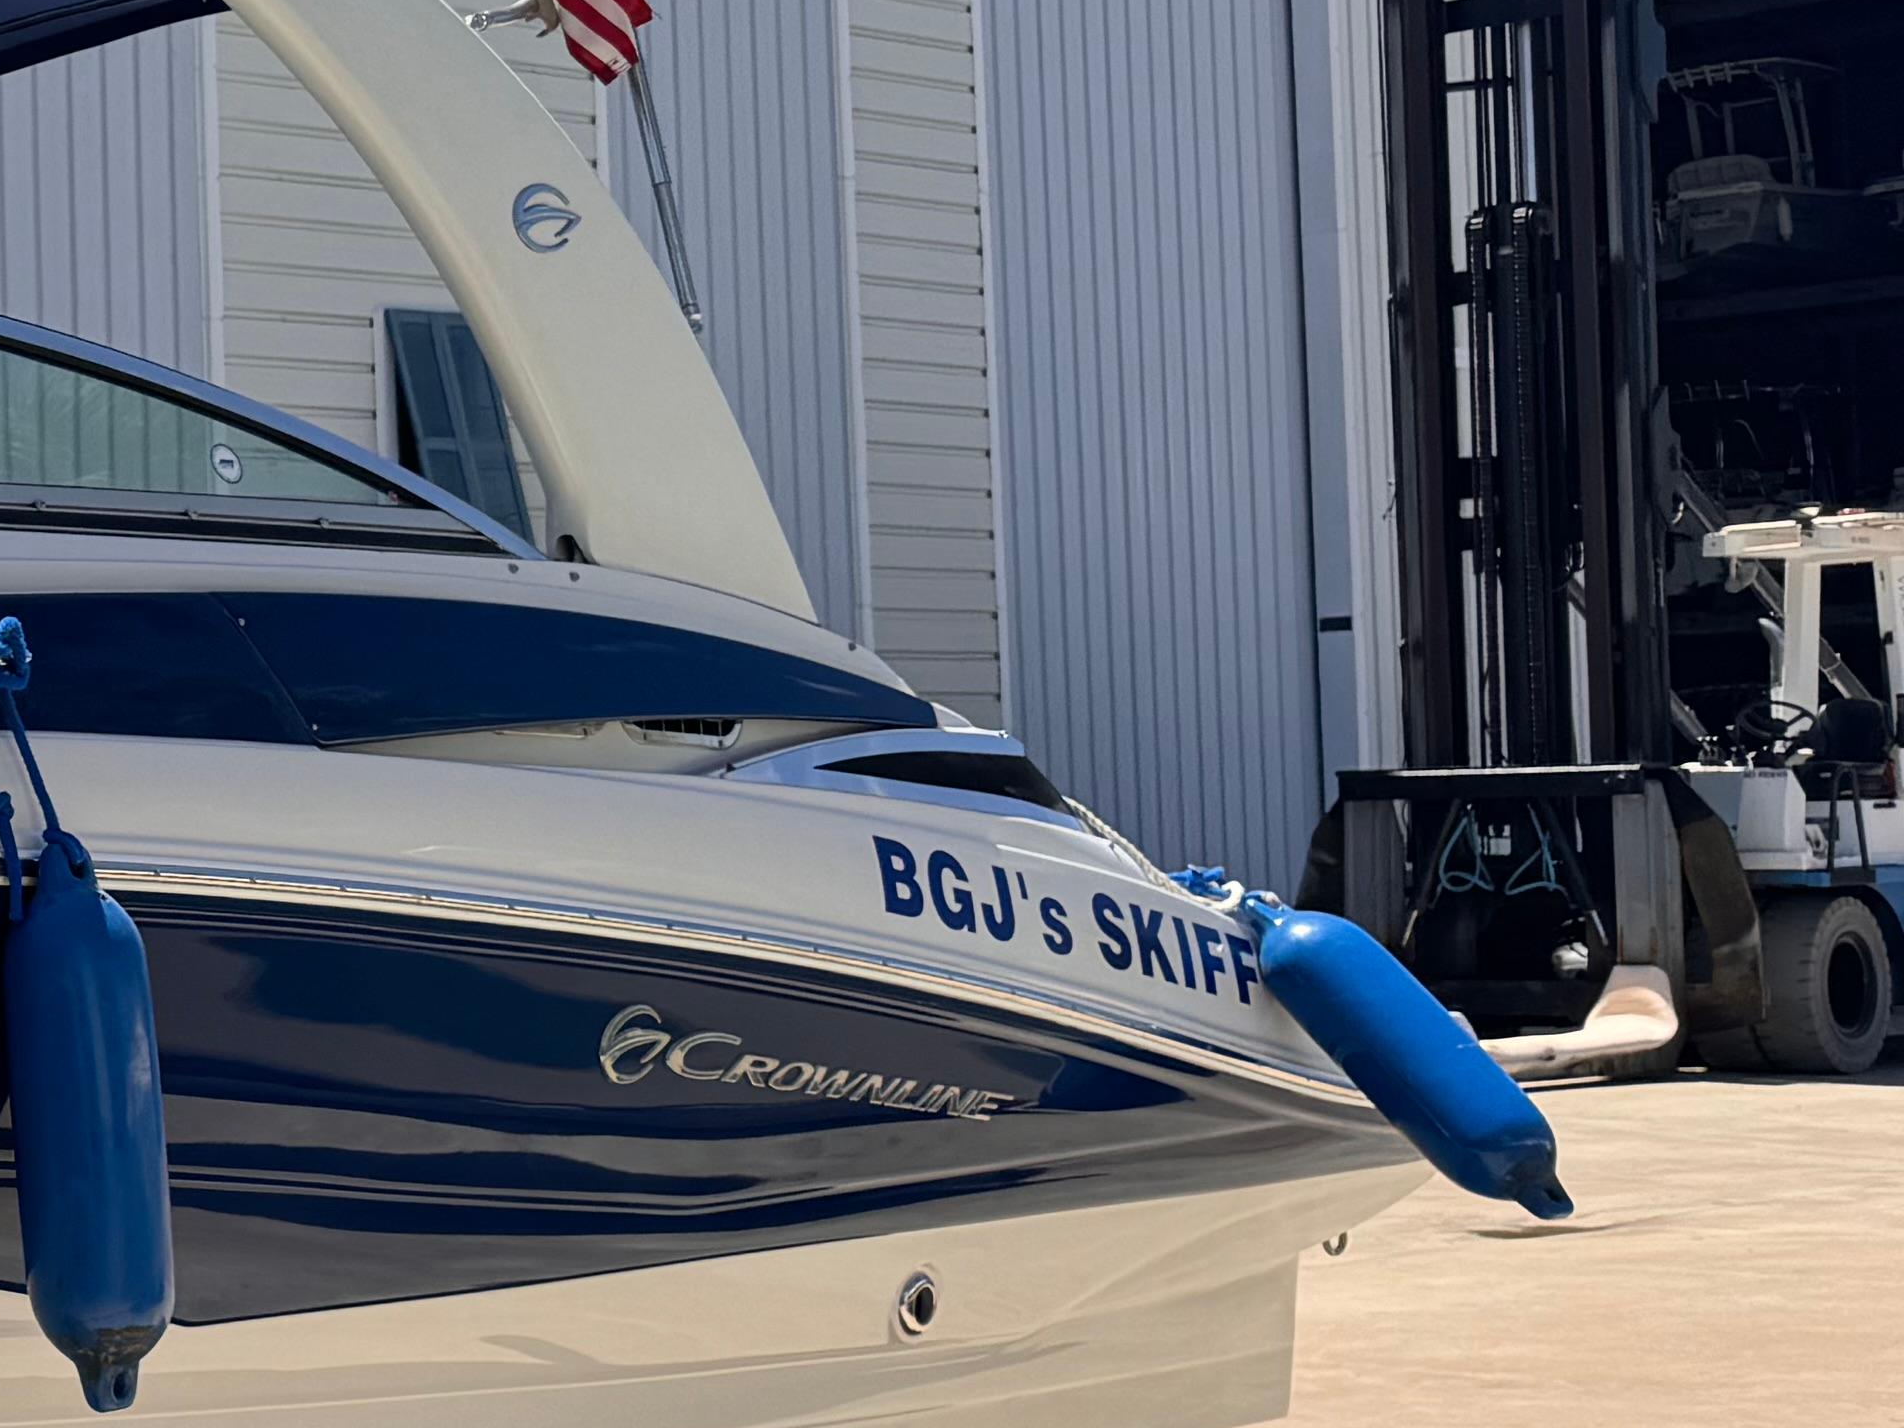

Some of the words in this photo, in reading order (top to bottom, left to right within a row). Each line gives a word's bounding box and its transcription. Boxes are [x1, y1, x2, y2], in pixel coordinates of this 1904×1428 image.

[872, 835, 1073, 956] BGJ's
[1092, 892, 1260, 1005] SKIFF
[666, 1032, 1015, 1121] CROWNLINE
